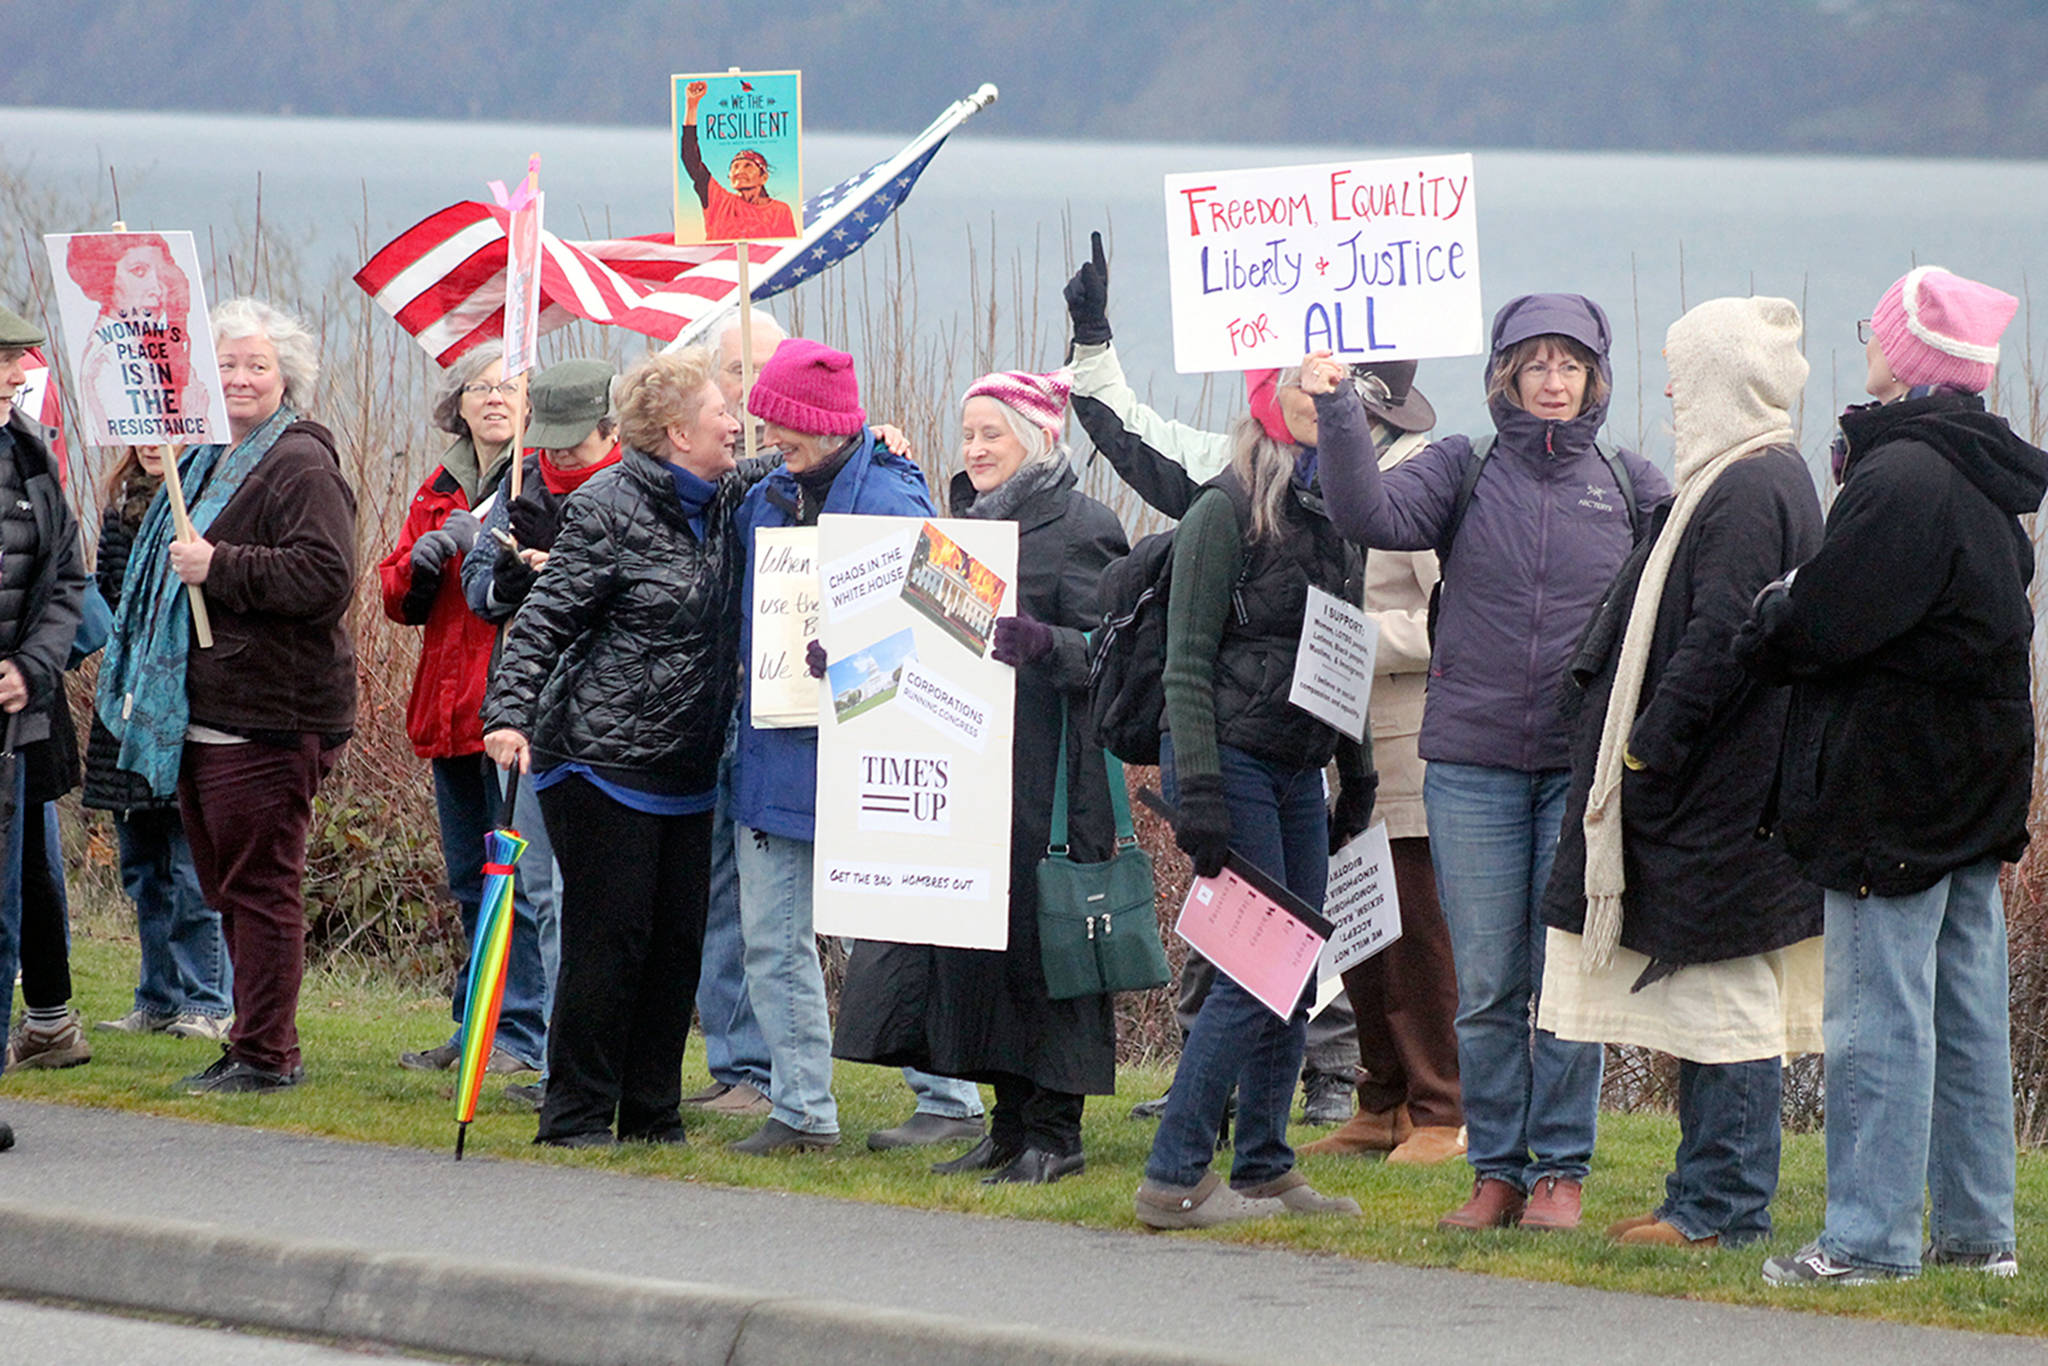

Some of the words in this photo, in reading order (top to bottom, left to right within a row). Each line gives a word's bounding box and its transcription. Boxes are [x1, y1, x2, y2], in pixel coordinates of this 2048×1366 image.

[731, 94, 744, 110] WE
[747, 94, 764, 109] THE
[706, 112, 789, 140] RESILIENT
[131, 307, 139, 316] A
[95, 321, 181, 345] WOMAN'S
[1226, 313, 1278, 356] FOR
[1304, 296, 1396, 356] ALL
[117, 343, 168, 359] PLACE
[121, 363, 144, 385] IS
[149, 363, 173, 384] IN
[125, 389, 178, 414] THE
[107, 418, 205, 436] RESISTANCE
[759, 545, 811, 575] When
[829, 563, 866, 589] CHAOS
[867, 557, 880, 573] IN
[881, 547, 902, 566] THE
[832, 584, 866, 608] WHITE
[868, 566, 904, 593] HOUSE
[759, 651, 793, 680] We
[907, 672, 984, 725] CORPORATIONS
[903, 687, 938, 714] RUNNING
[938, 708, 979, 738] CONGRESS
[862, 755, 948, 789] TIME'S
[913, 792, 947, 821] UP
[830, 869, 851, 883] GET
[853, 872, 871, 885] THE
[873, 874, 893, 887] BAD
[902, 874, 950, 889] HOMBRES
[952, 879, 974, 891] OUT
[1329, 856, 1363, 882] BIGOTRY
[1329, 863, 1379, 899] XENOPHOBIA
[1351, 936, 1371, 953] WILL
[1372, 928, 1383, 942] WE
[1333, 948, 1350, 965] NOT
